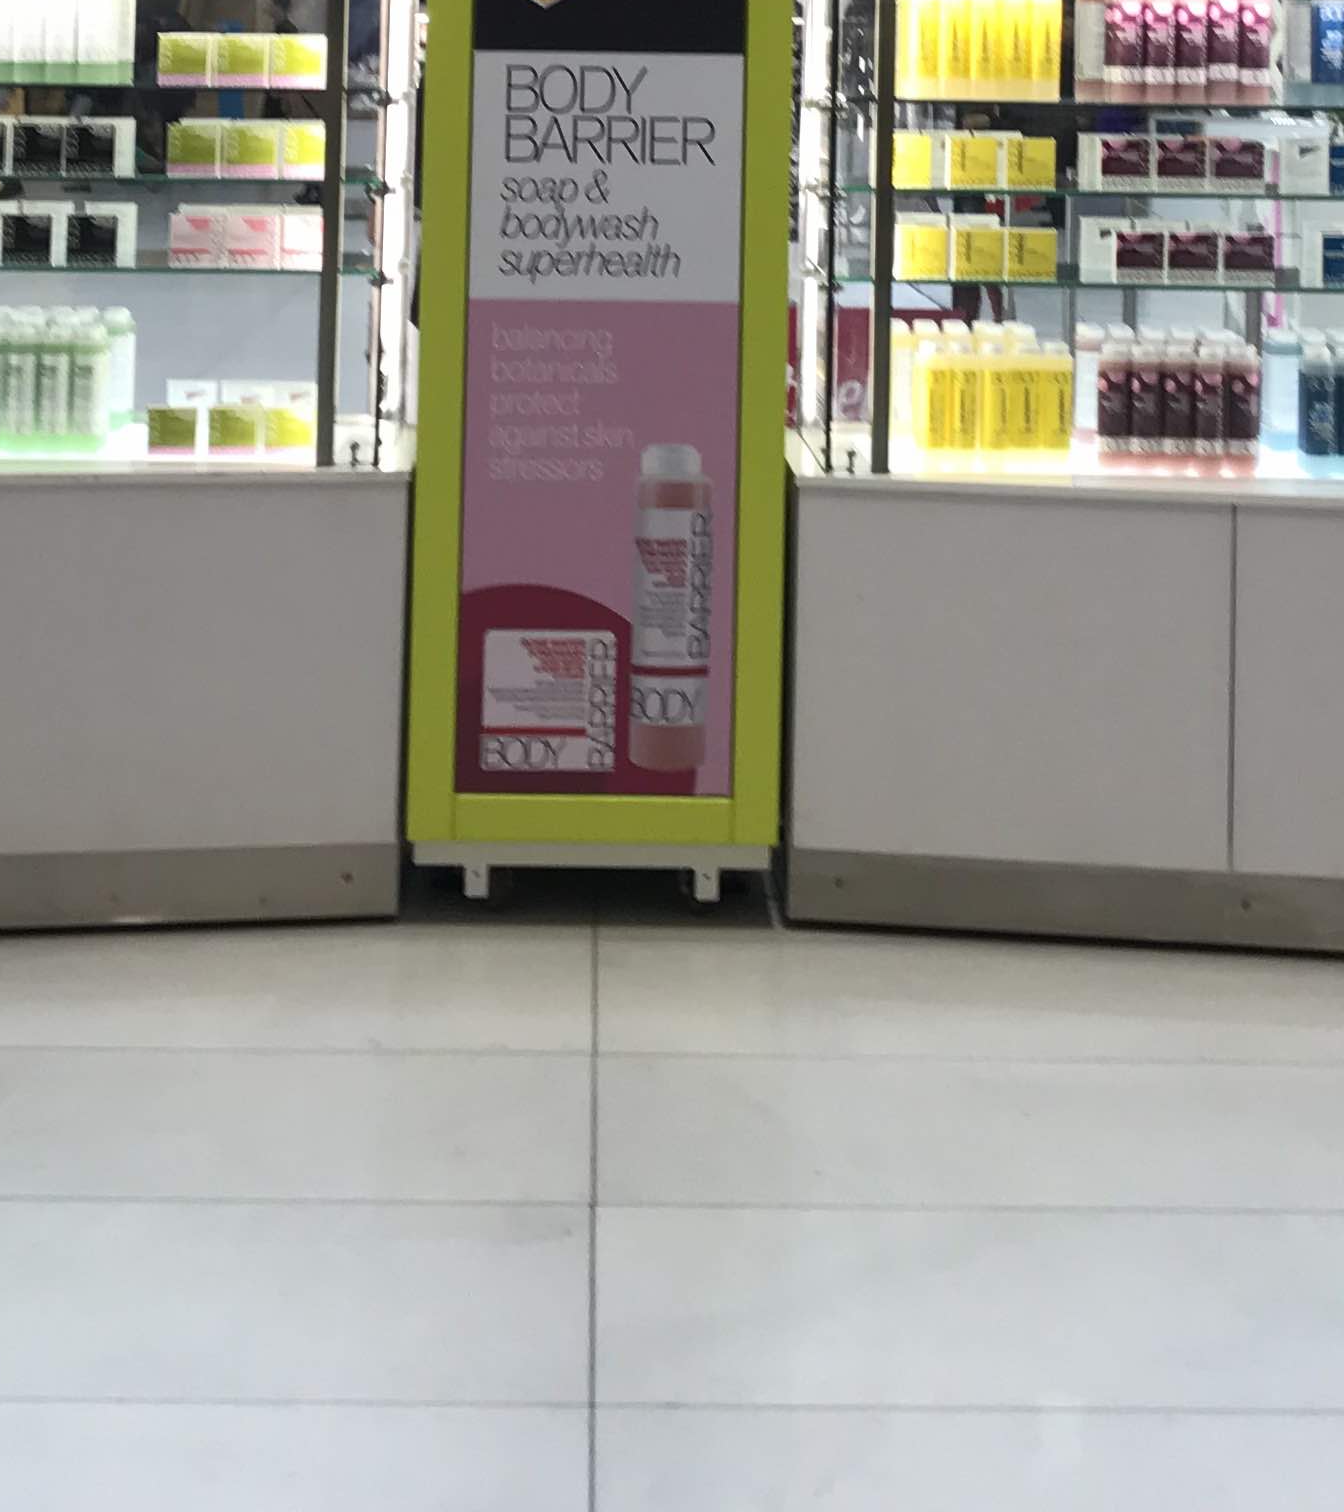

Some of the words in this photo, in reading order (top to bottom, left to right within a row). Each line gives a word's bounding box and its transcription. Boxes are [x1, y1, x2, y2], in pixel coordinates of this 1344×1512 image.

[504, 64, 648, 115] BODY
[503, 115, 716, 166] BARRIER
[499, 175, 578, 208] soap
[585, 168, 610, 205] &
[498, 206, 659, 247] bodywash
[497, 242, 681, 284] superhealth
[489, 388, 581, 419] protect
[488, 424, 579, 456] against
[580, 419, 634, 450] skin
[488, 455, 605, 482] stressors
